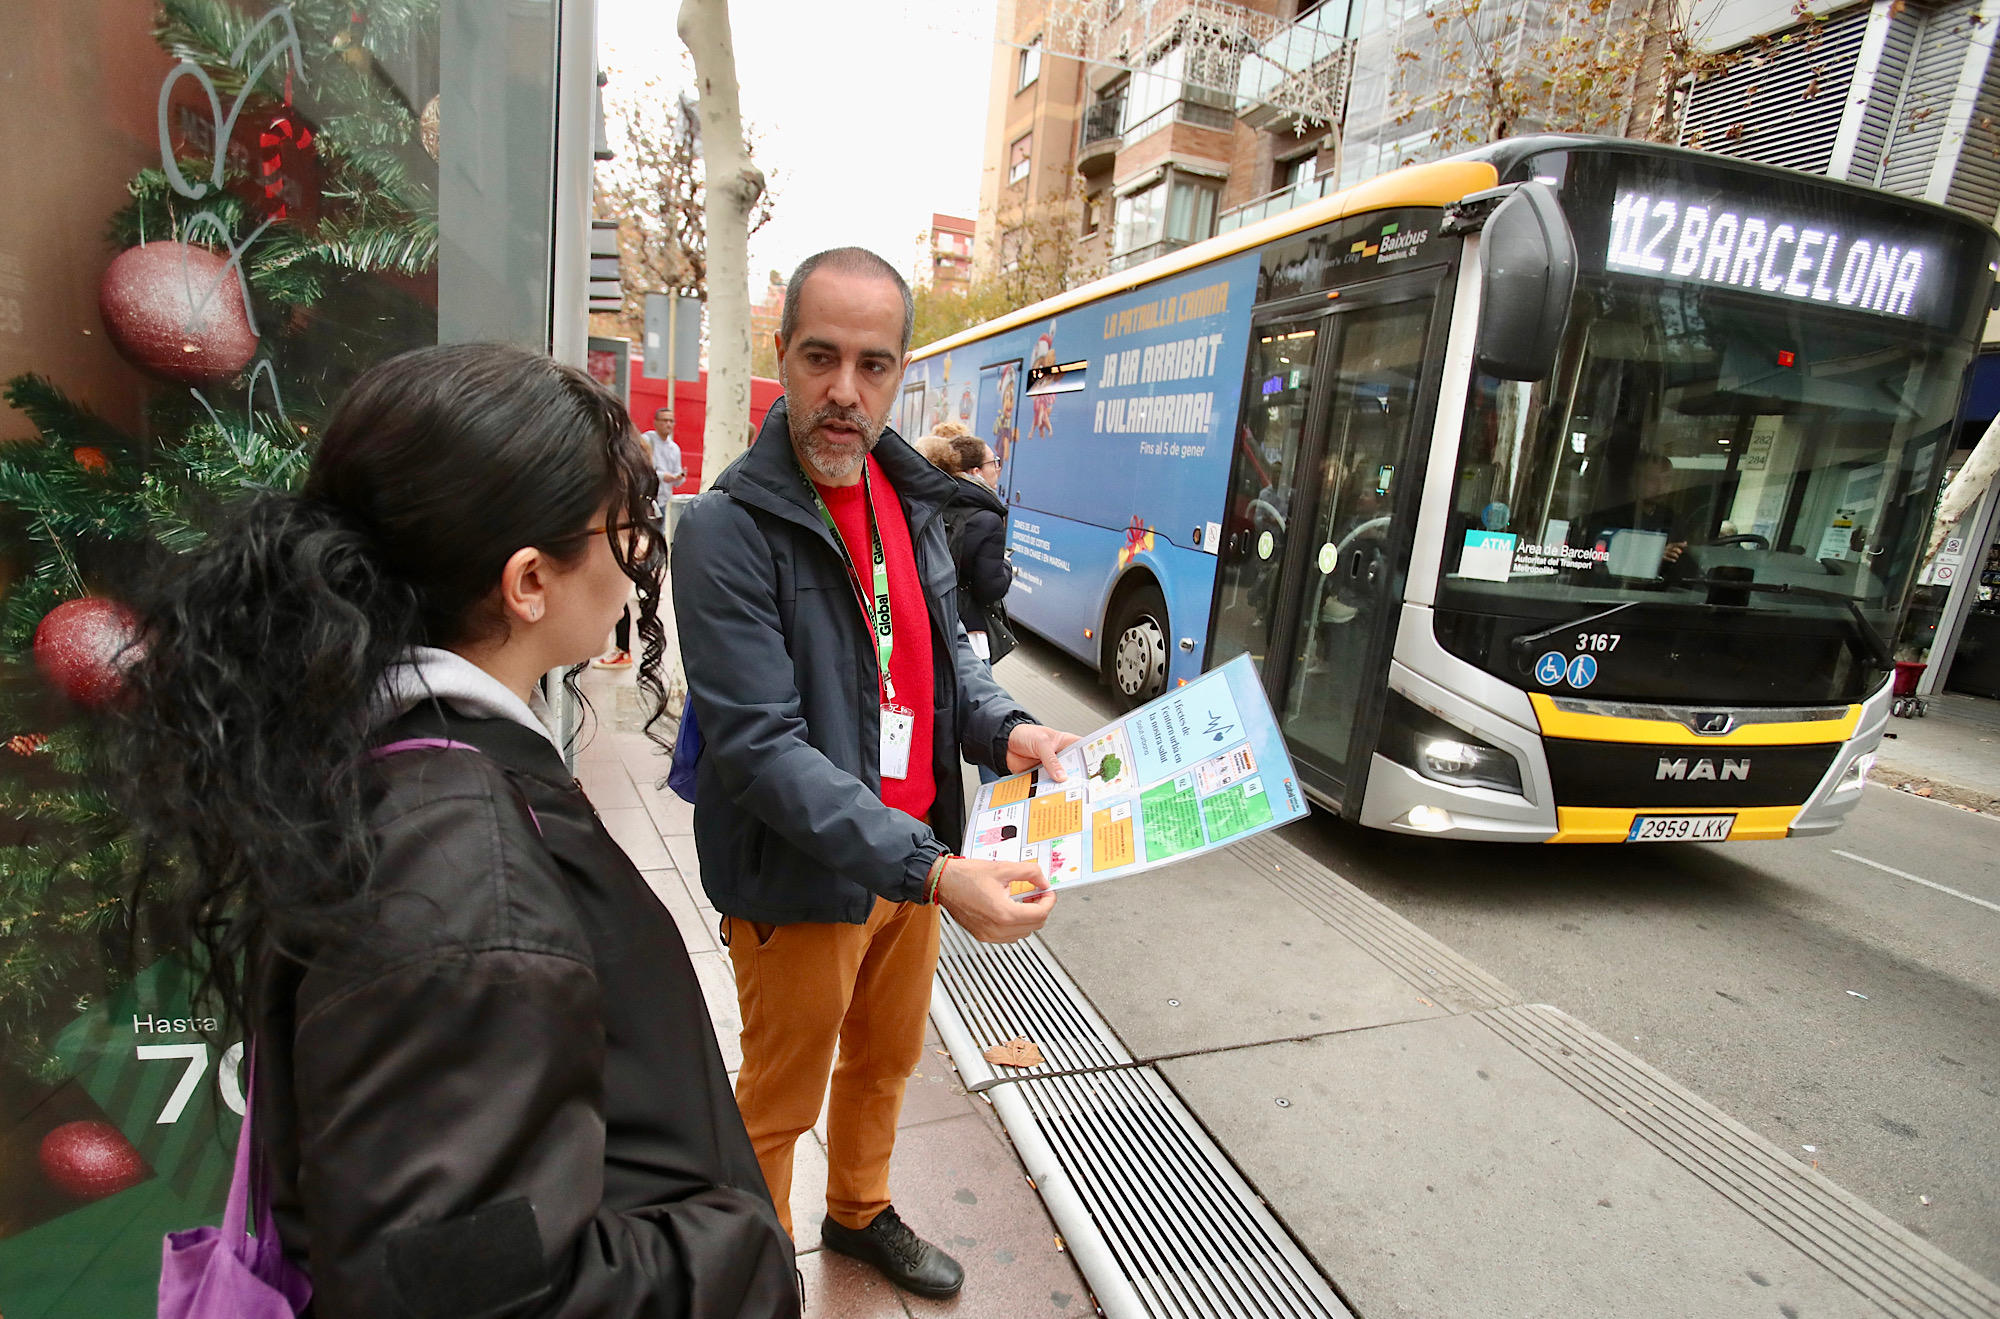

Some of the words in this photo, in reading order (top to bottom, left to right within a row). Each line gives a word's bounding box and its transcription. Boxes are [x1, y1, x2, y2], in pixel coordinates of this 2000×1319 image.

[1379, 229, 1428, 253] Baixbus
[1670, 204, 1926, 316] BARCELONA
[1104, 313, 1118, 340] LA
[1117, 296, 1178, 337] PATRULLA
[1177, 281, 1230, 323] CANINA
[1099, 352, 1118, 389] JA
[1118, 349, 1141, 387] HA
[1141, 333, 1223, 384] ARRIBAT
[1094, 401, 1106, 433] A
[1105, 391, 1214, 434] VILAMARINA!
[1753, 435, 1771, 445] 282
[1140, 441, 1154, 455] Fins
[1155, 441, 1163, 455] al
[1163, 443, 1169, 456] 5
[1169, 442, 1180, 456] de
[1181, 444, 1205, 460] gener
[1748, 456, 1765, 464] 284
[1480, 537, 1512, 551] ATM
[1516, 538, 1543, 555] Àrea
[1543, 544, 1558, 556] de
[1560, 545, 1610, 561] Barcelona
[1514, 554, 1547, 566] Autoritat
[1547, 557, 1560, 566] del
[1560, 558, 1592, 570] Transport
[1575, 633, 1621, 652] 3167
[1148, 712, 1157, 721] la
[1173, 699, 1187, 727] Efectes
[1181, 726, 1191, 737] de
[1136, 719, 1144, 735] Salut
[1140, 734, 1149, 756] urbana
[1151, 721, 1163, 745] nostra
[1158, 744, 1169, 763] salut
[1170, 735, 1182, 754] urbà
[1174, 752, 1182, 764] en
[1655, 757, 1752, 781] MAN
[1178, 778, 1187, 788] 02
[1641, 820, 1690, 838] 2959
[1692, 820, 1729, 838] LKK
[133, 1013, 218, 1034] Hasta
